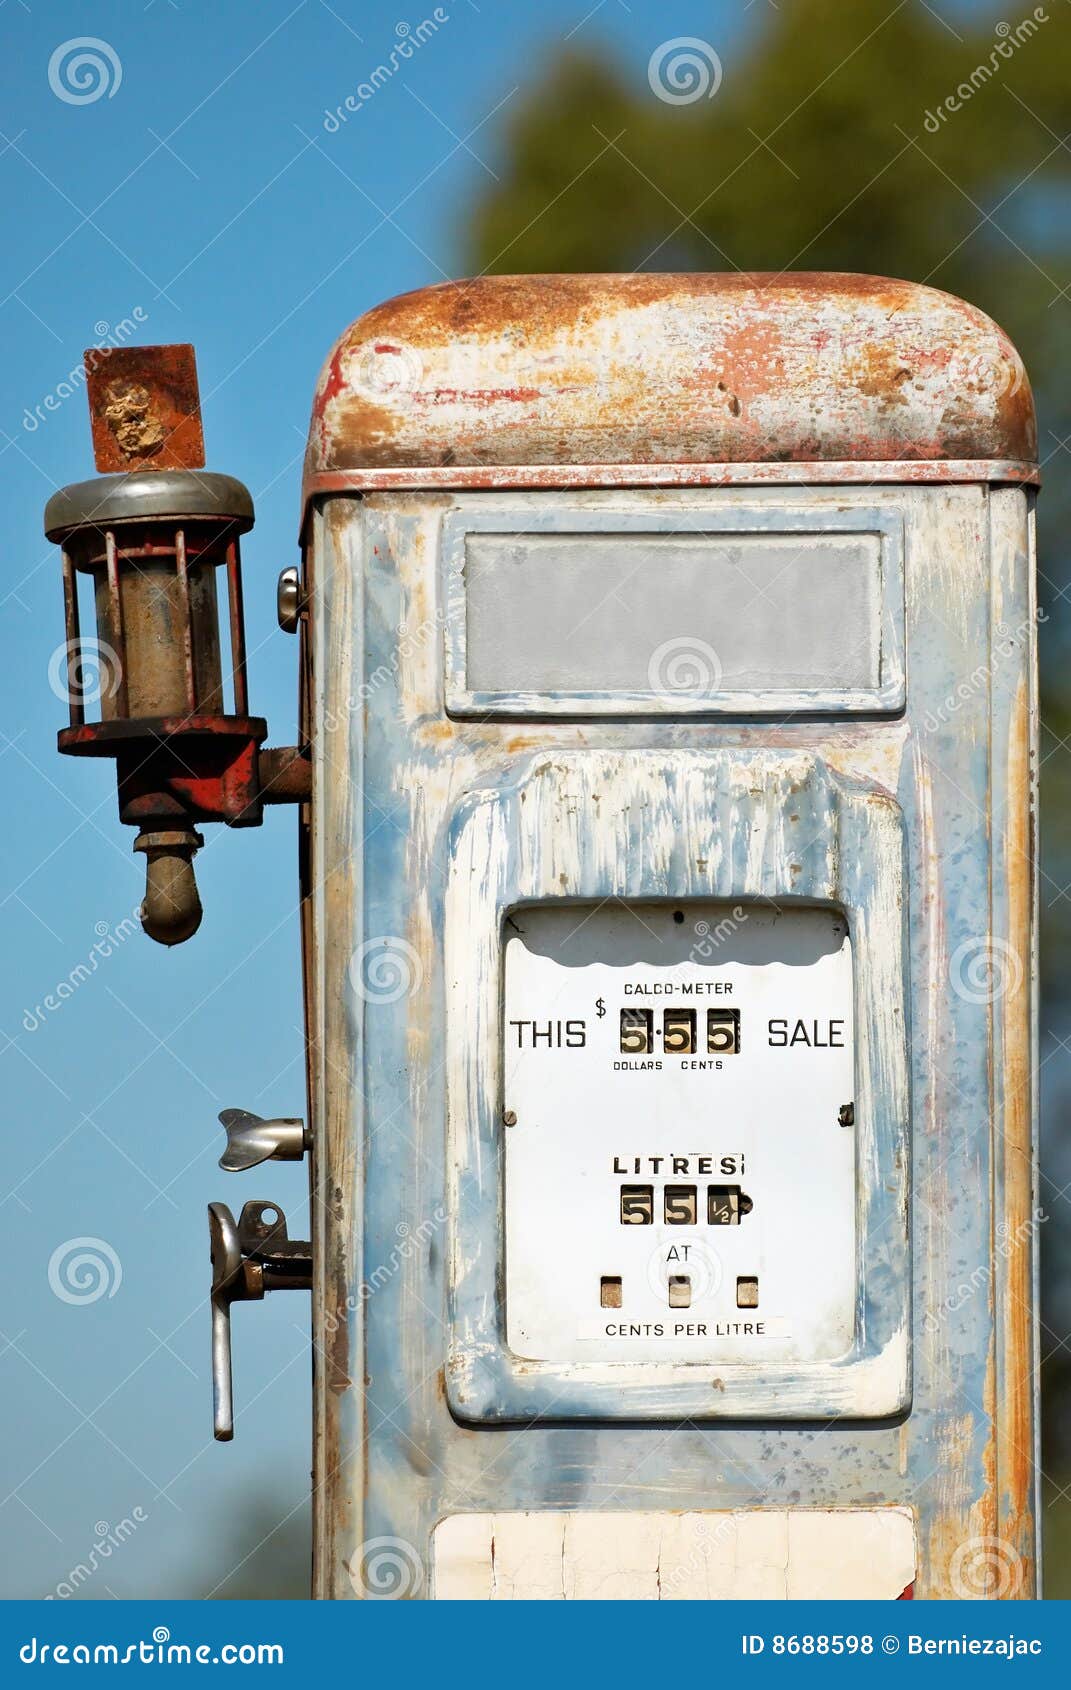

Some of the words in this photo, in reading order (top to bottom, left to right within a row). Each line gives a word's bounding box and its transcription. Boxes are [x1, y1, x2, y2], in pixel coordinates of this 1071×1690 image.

[624, 983, 733, 995] CALCO-METER
[509, 1020, 586, 1048] THIS
[768, 1019, 845, 1047] SALE
[613, 1061, 663, 1071] DOLLARS
[681, 1060, 723, 1070] CENTS
[613, 1157, 737, 1175] LITRES
[666, 1245, 692, 1262] AT
[605, 1324, 664, 1336] CENTS
[674, 1323, 707, 1336] PER
[716, 1323, 766, 1335] LITRE
